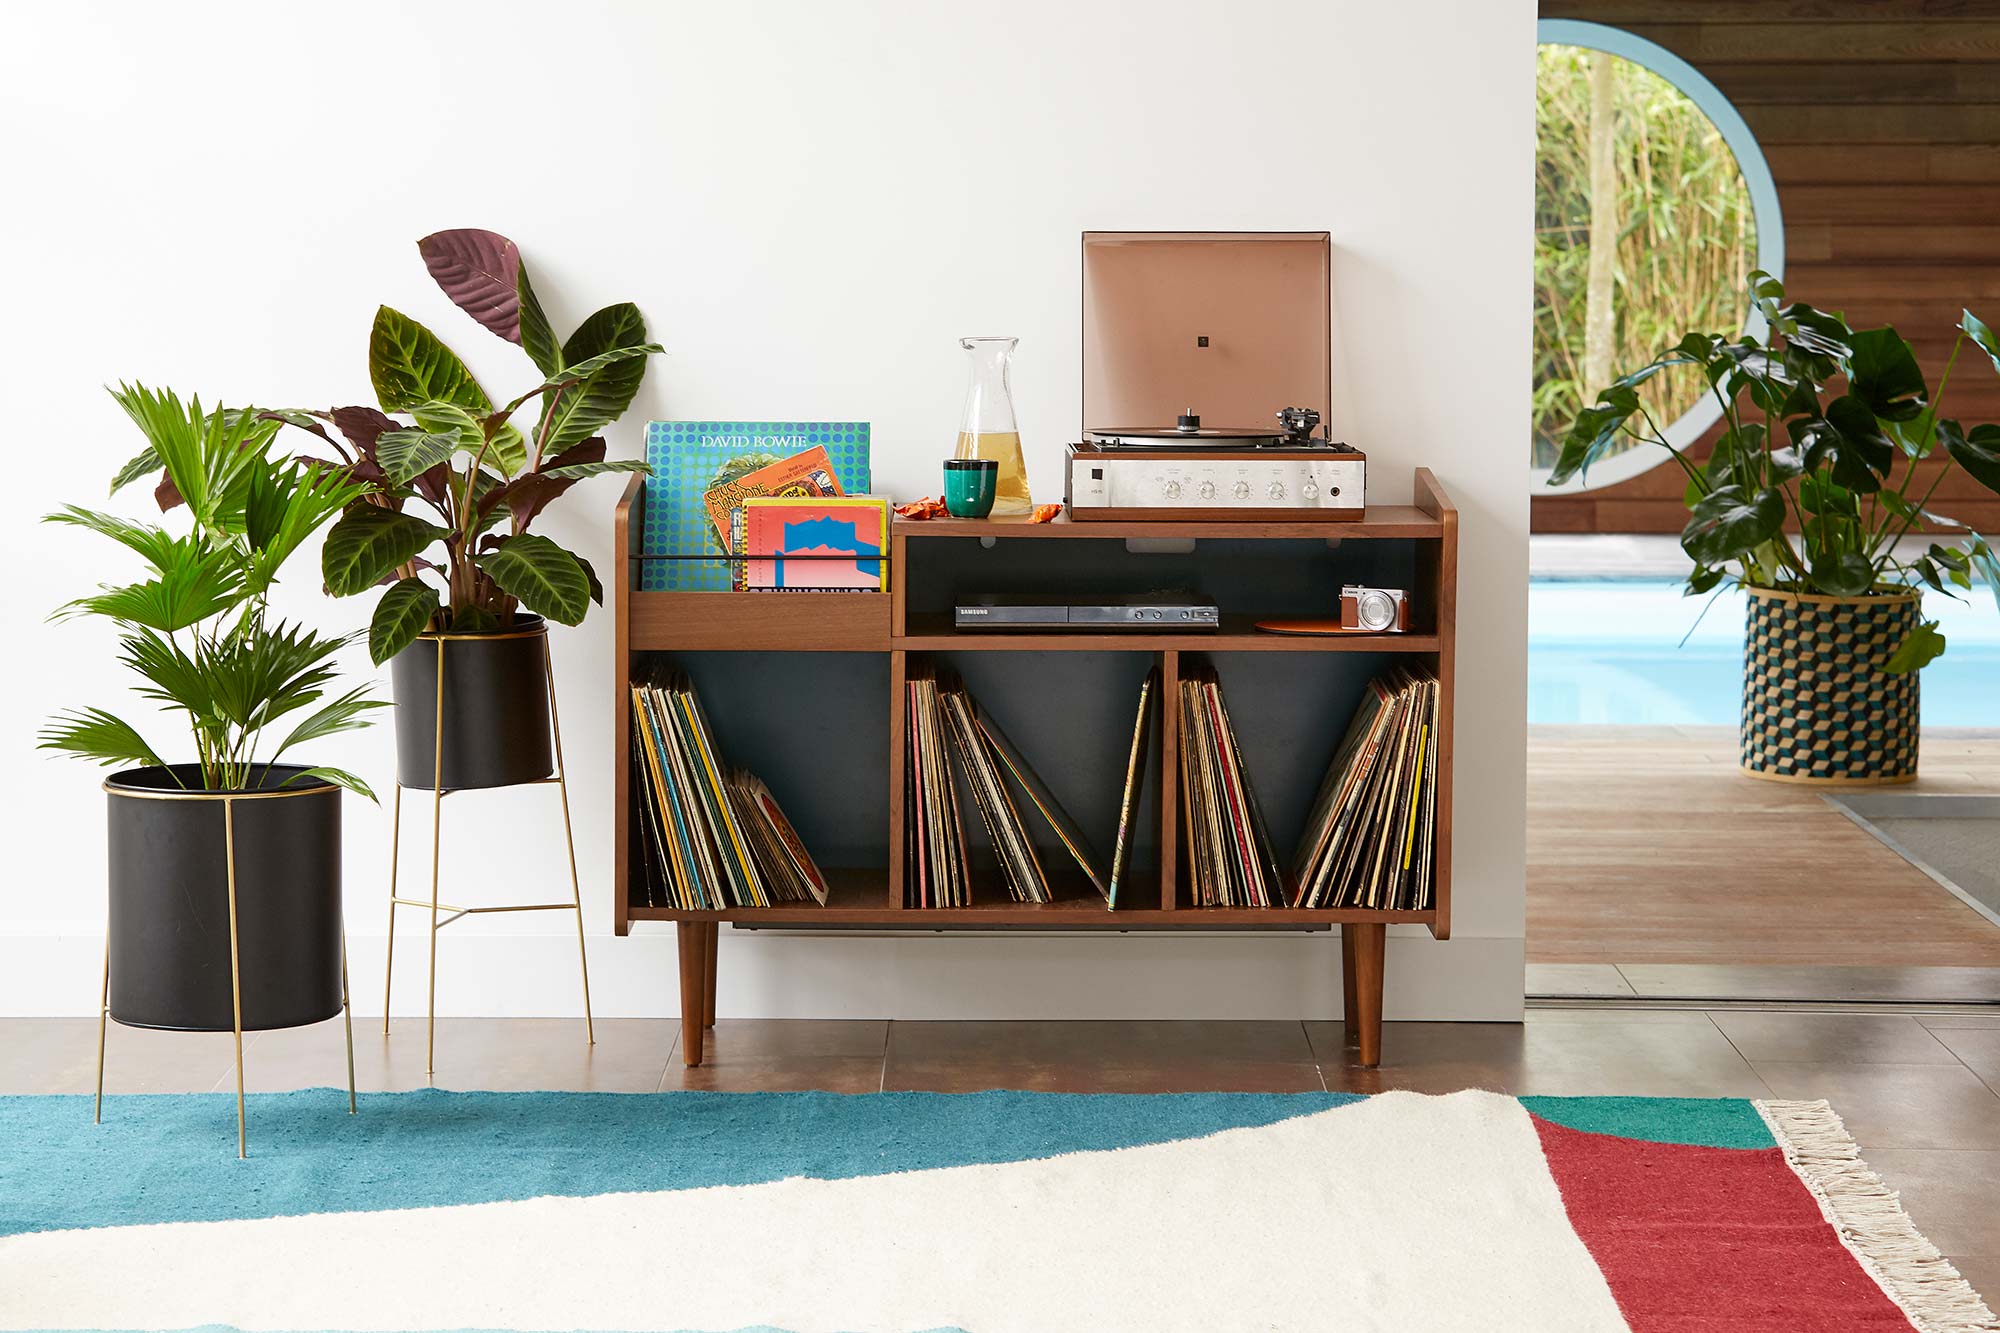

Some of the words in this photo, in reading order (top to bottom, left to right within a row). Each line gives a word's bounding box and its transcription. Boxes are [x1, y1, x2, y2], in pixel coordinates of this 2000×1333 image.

[701, 435, 749, 448] DAVID
[753, 435, 807, 448] BOWIE
[706, 480, 740, 501] CHUCK
[711, 483, 769, 514] MANGIONE
